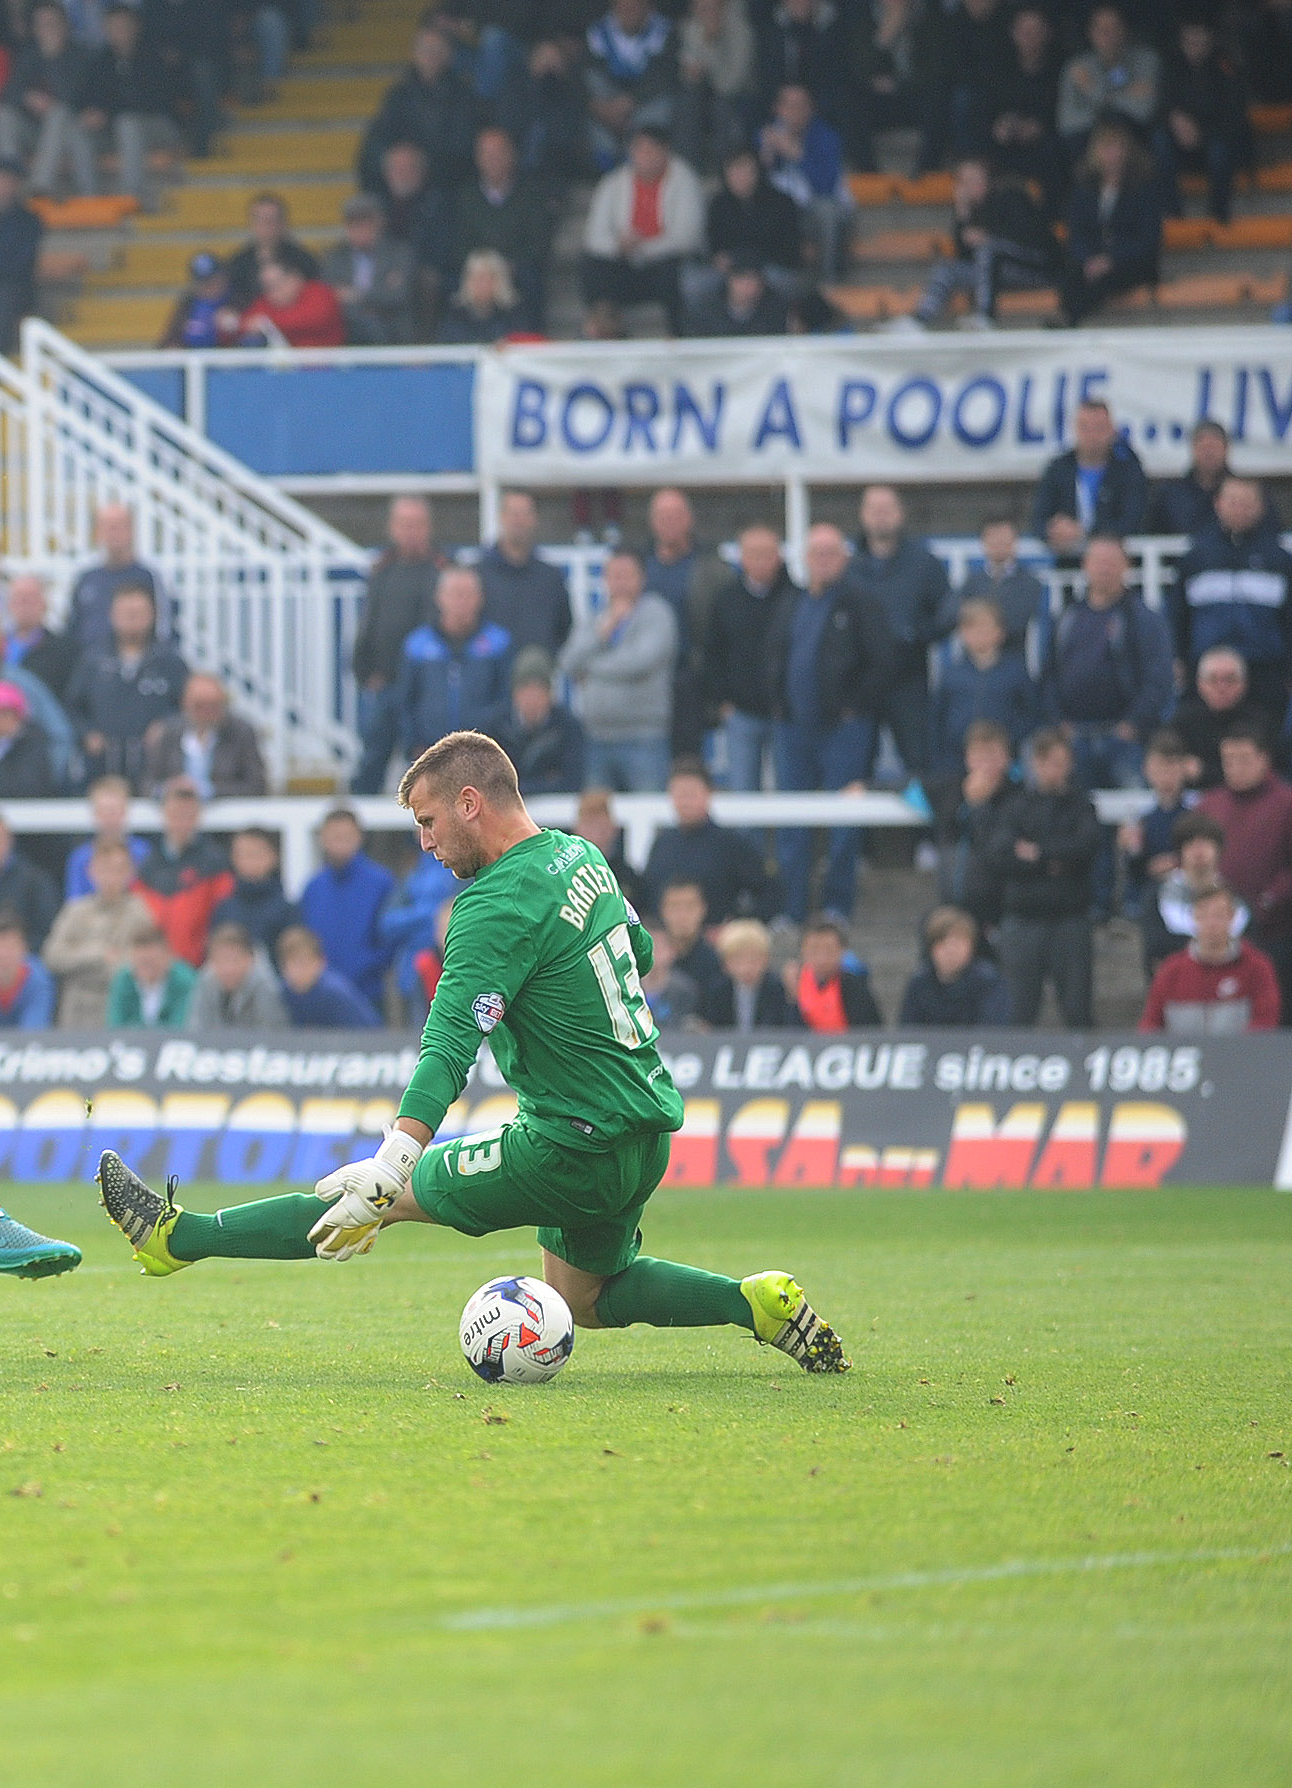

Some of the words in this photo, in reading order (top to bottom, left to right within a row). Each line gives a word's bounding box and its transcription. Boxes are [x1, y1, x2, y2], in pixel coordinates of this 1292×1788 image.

[511, 376, 720, 453] BORN
[754, 374, 805, 451] A
[587, 922, 654, 1051] 13
[712, 1045, 928, 1090] LEAGUE
[935, 1045, 1071, 1092] since
[650, 1098, 842, 1187] ASA
[941, 1100, 1188, 1189] MAR
[464, 1306, 502, 1346] mitre
